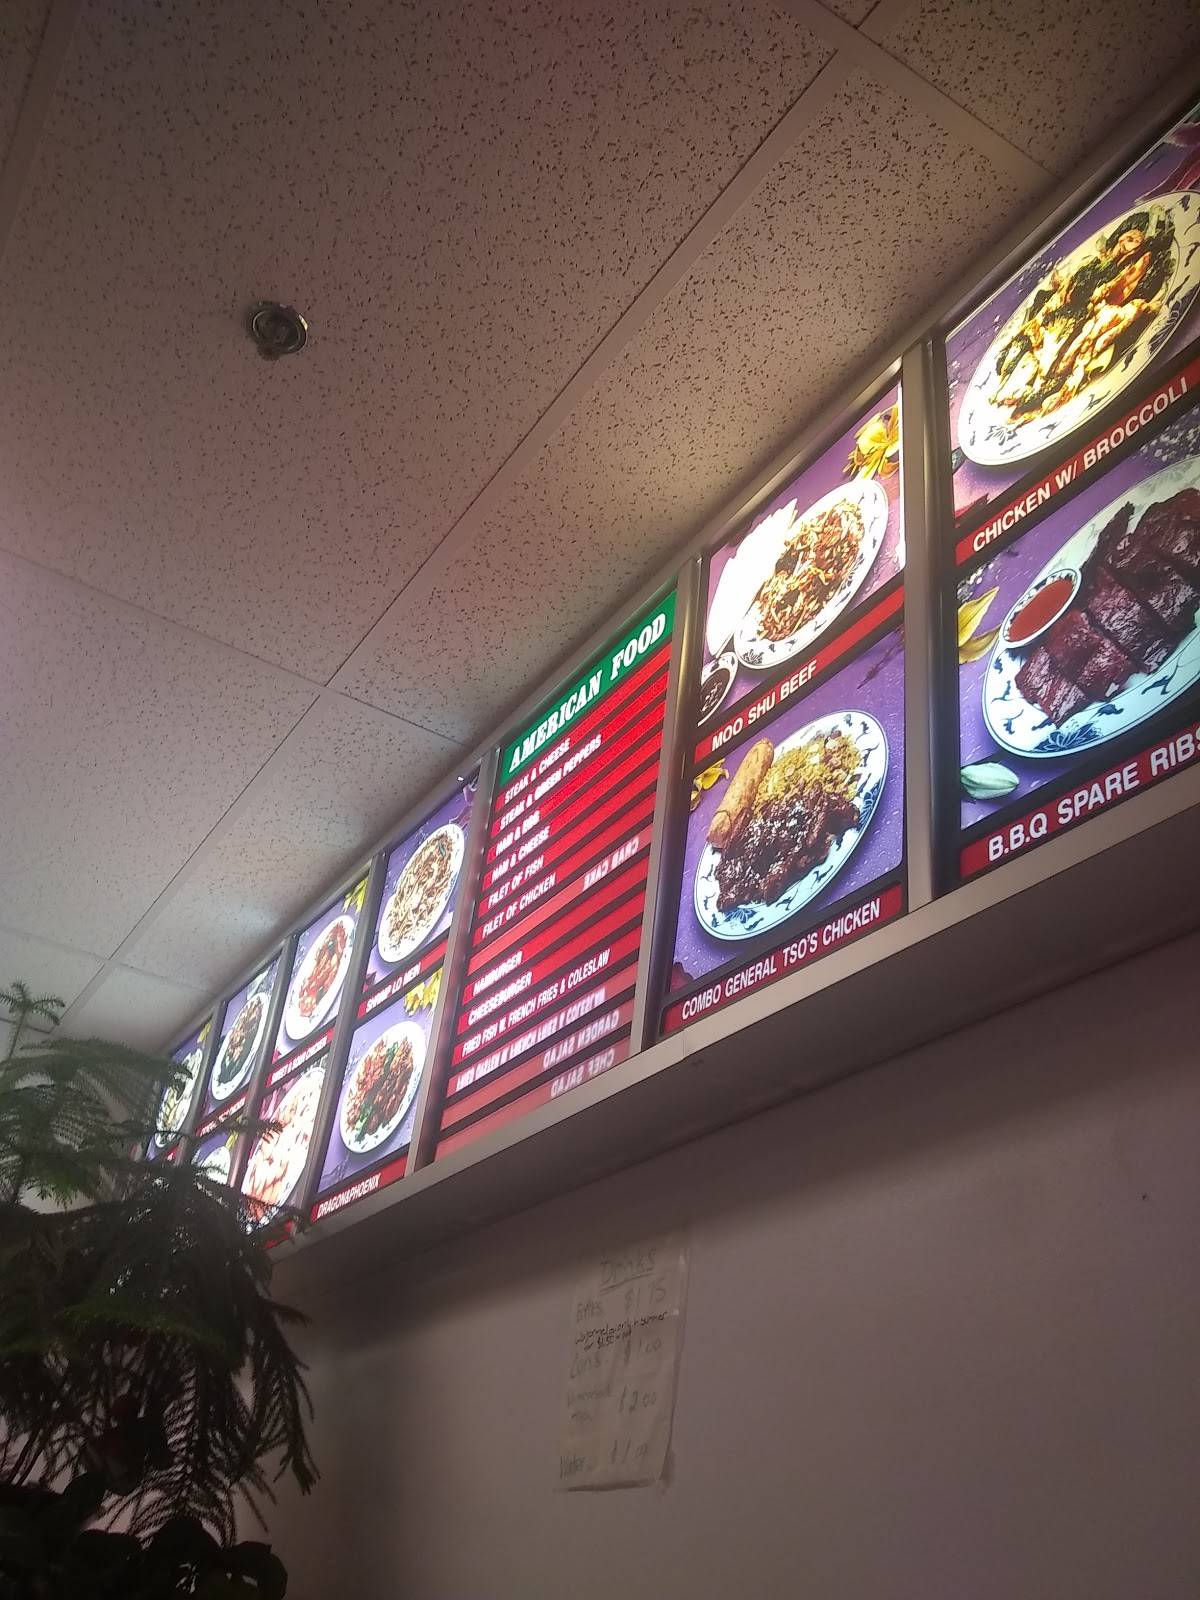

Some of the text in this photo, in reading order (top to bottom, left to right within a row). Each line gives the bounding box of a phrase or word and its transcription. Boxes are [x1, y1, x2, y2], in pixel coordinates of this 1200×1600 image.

[972, 376, 1189, 553] CHICKEN W/ BROCCOLI
[508, 613, 666, 774] AMERICAN FOOD
[711, 659, 818, 753] MOO SHU BEEF
[504, 773, 529, 804] STEAK
[538, 737, 571, 774] CHEESE
[518, 825, 551, 860] CHEESE
[987, 812, 1048, 862] B.B.Q
[1056, 762, 1141, 826] SPARE
[482, 872, 556, 939] FILET OF CHICKEN
[488, 855, 545, 909] FILET OF FISH
[468, 971, 532, 1026] CHEESEBURGER
[508, 997, 537, 1028] FRENCH
[537, 982, 559, 1009] FRIES
[559, 978, 566, 995] &
[567, 948, 611, 989] COLESLAW
[681, 897, 881, 1020] COMBO GENERAL TSO'S CHICKEN
